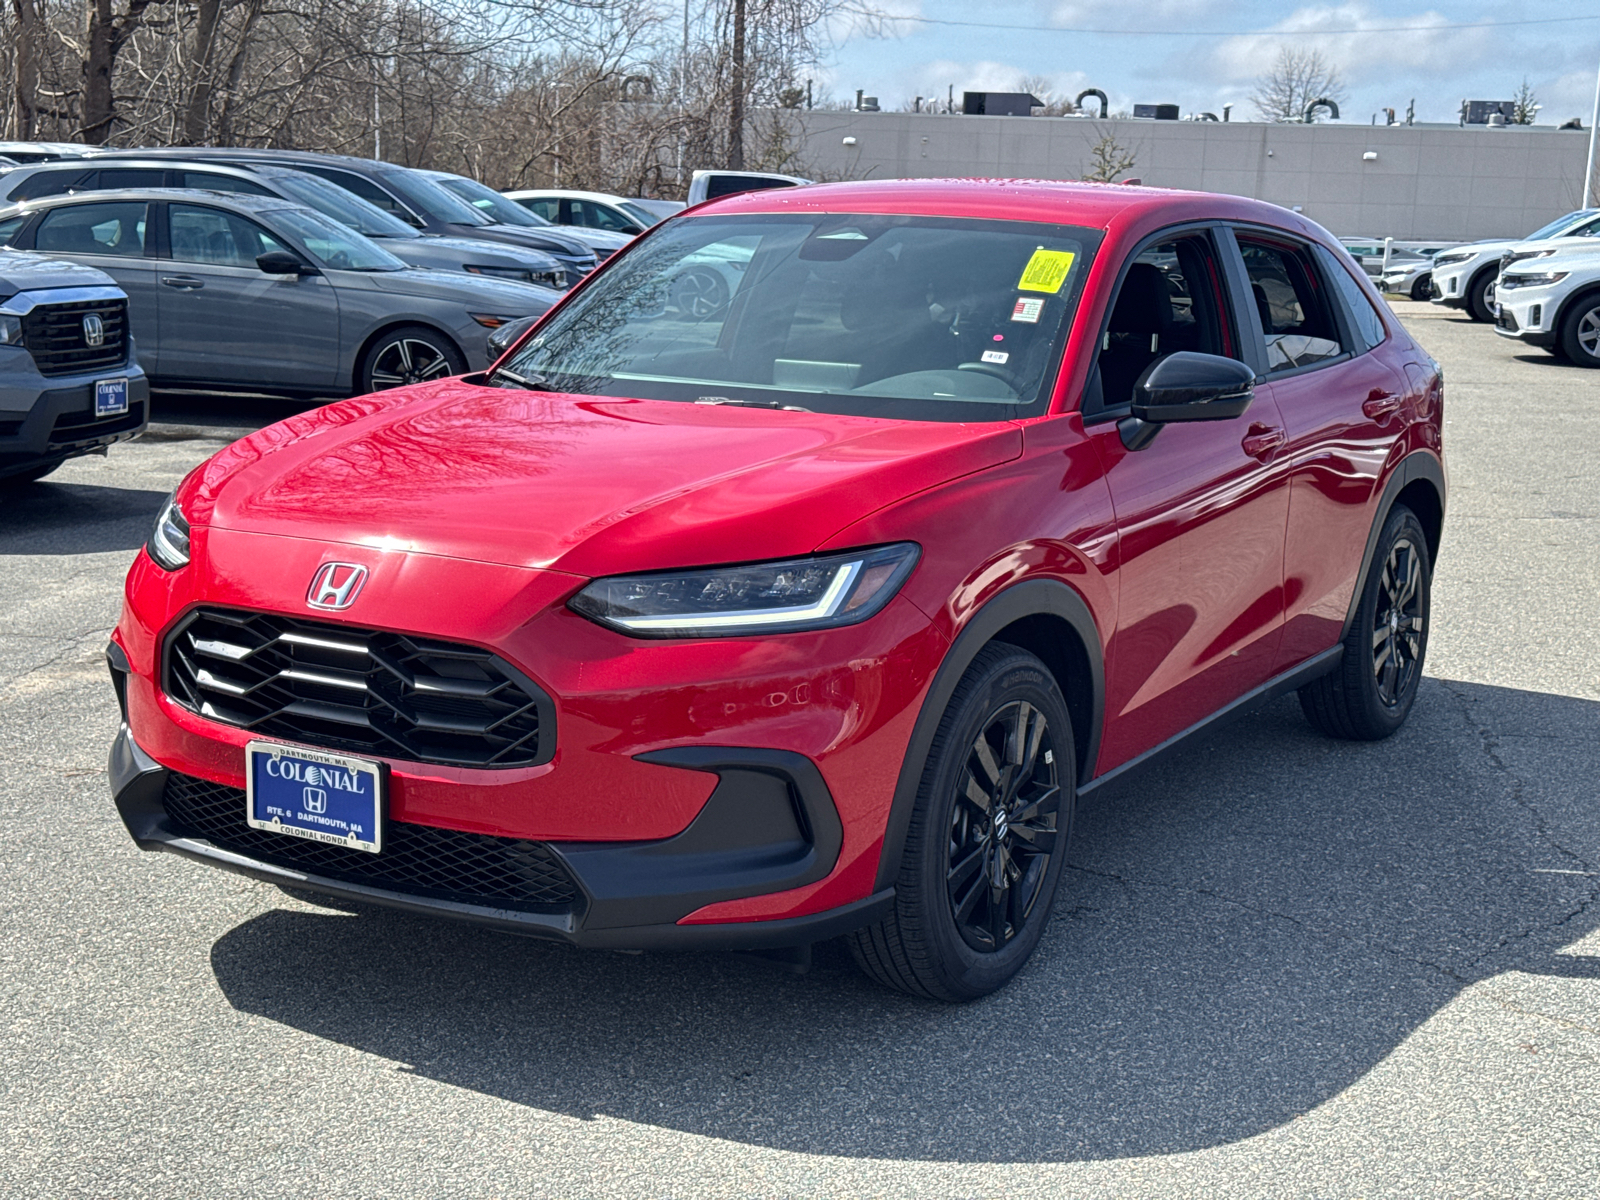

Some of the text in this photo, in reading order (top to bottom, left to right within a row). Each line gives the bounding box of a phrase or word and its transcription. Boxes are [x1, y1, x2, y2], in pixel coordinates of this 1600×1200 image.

[335, 759, 348, 767] MA
[266, 758, 365, 794] COLONIAL
[266, 805, 364, 833] RTE. 6 DARTMOUTH, MA
[280, 826, 348, 846] COLONIAL HONDA
